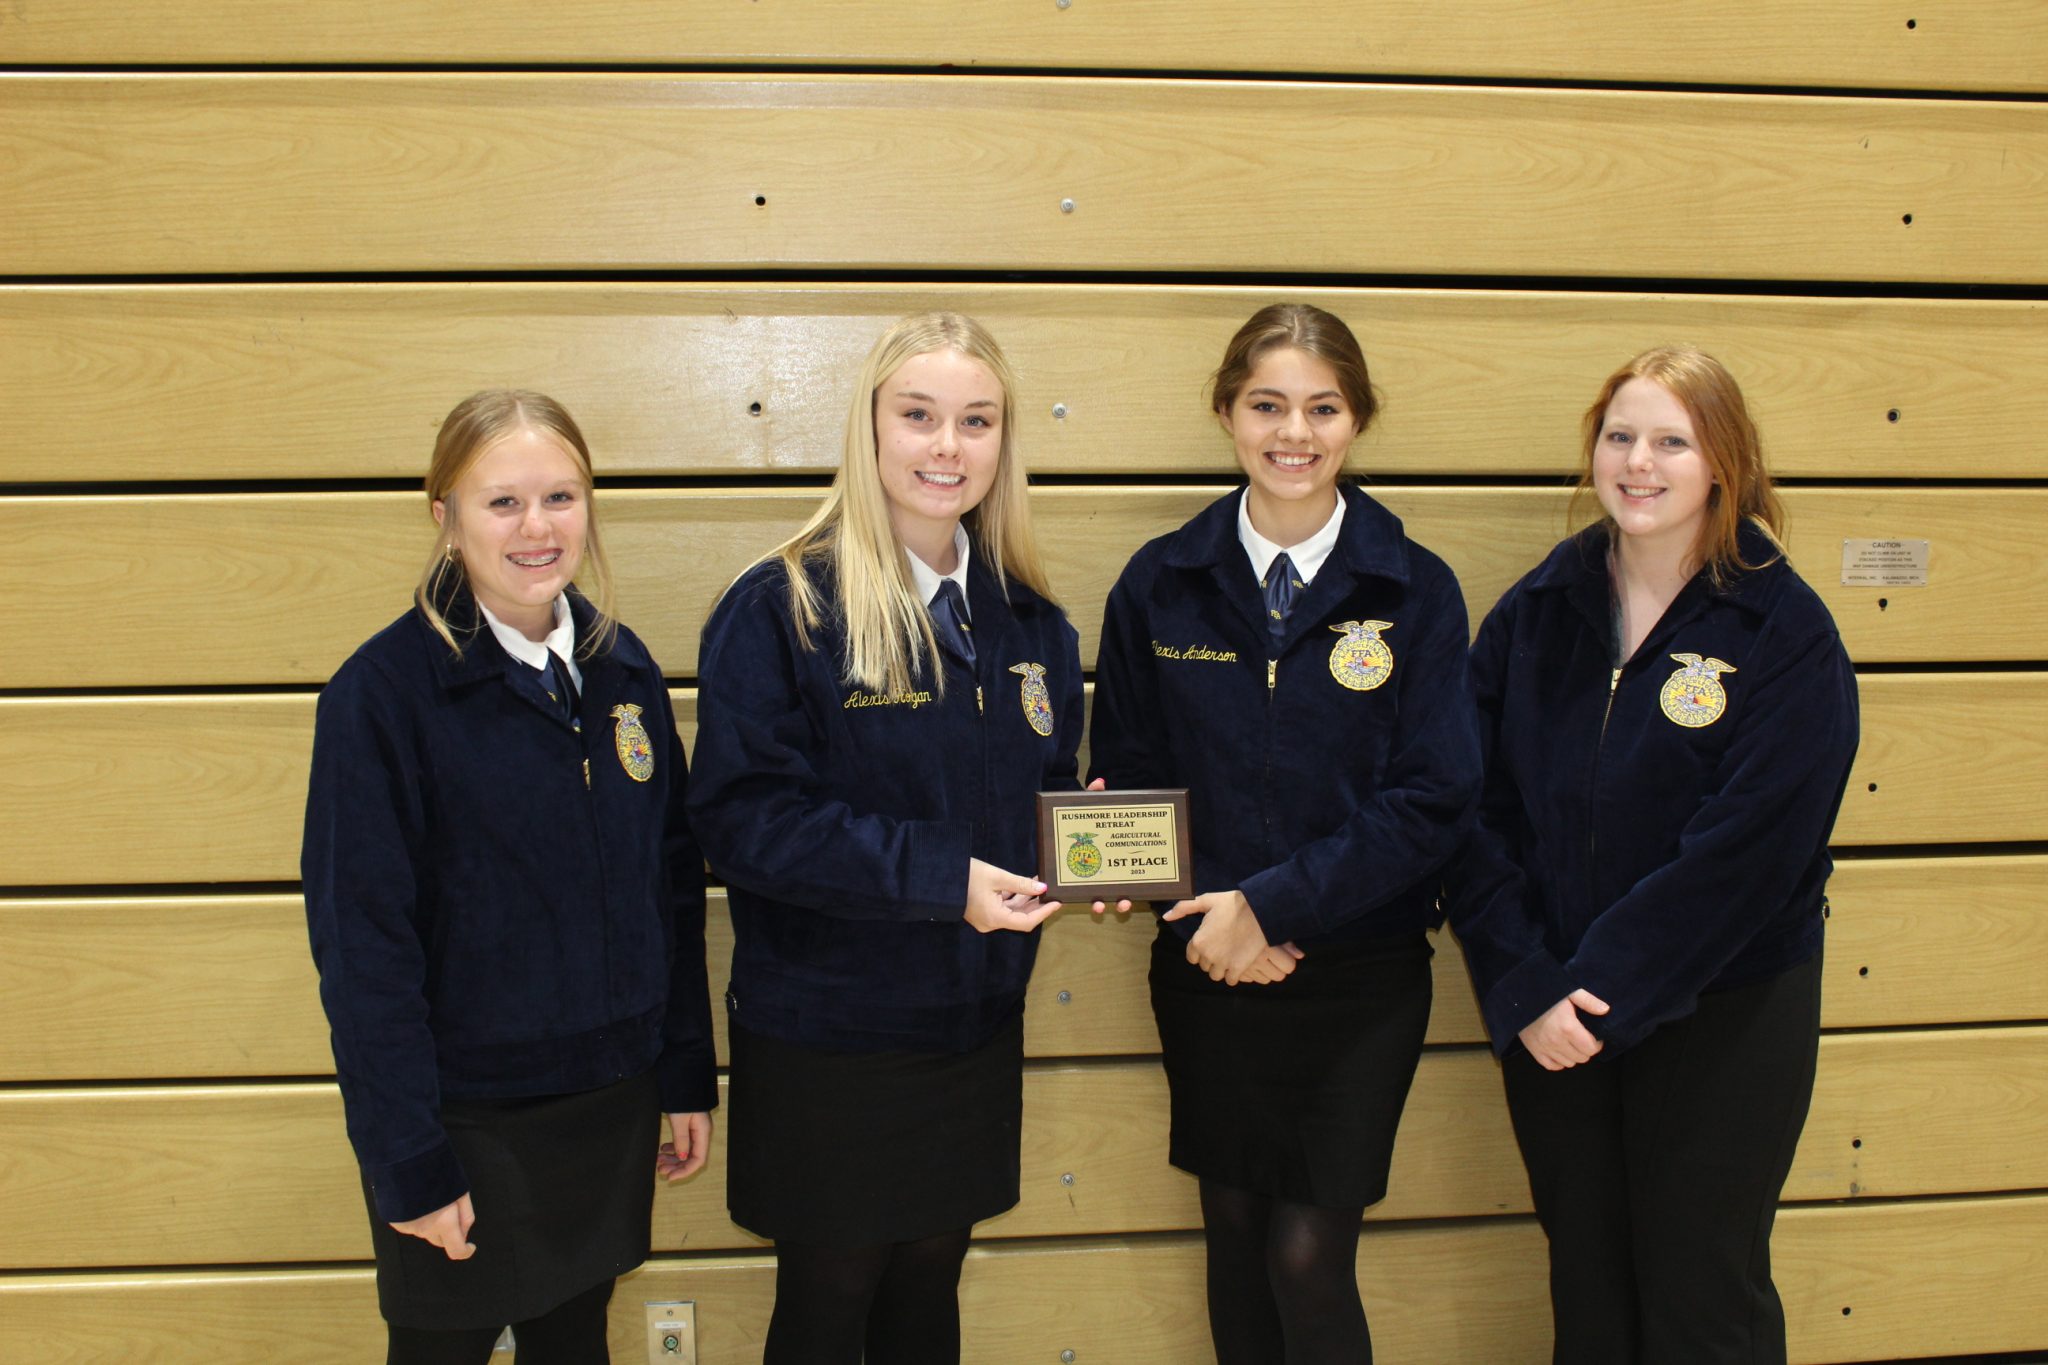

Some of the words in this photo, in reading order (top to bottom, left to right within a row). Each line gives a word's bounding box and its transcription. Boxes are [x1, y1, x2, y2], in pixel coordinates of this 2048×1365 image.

[1182, 644, 1237, 662] Anderson
[1351, 649, 1372, 658] FFA
[1685, 684, 1707, 697] FFA
[843, 690, 891, 709] Alexis
[1061, 812, 1111, 821] RUSHMORE
[1113, 810, 1168, 820] LEADERSHIP
[1095, 820, 1136, 829] RETREAT
[1110, 831, 1161, 839] AGRICULTURAL
[1105, 840, 1167, 848] COMMUNICATIONS
[1078, 851, 1092, 860] FFA
[1107, 858, 1128, 867] 1ST
[1131, 857, 1168, 866] PLACE
